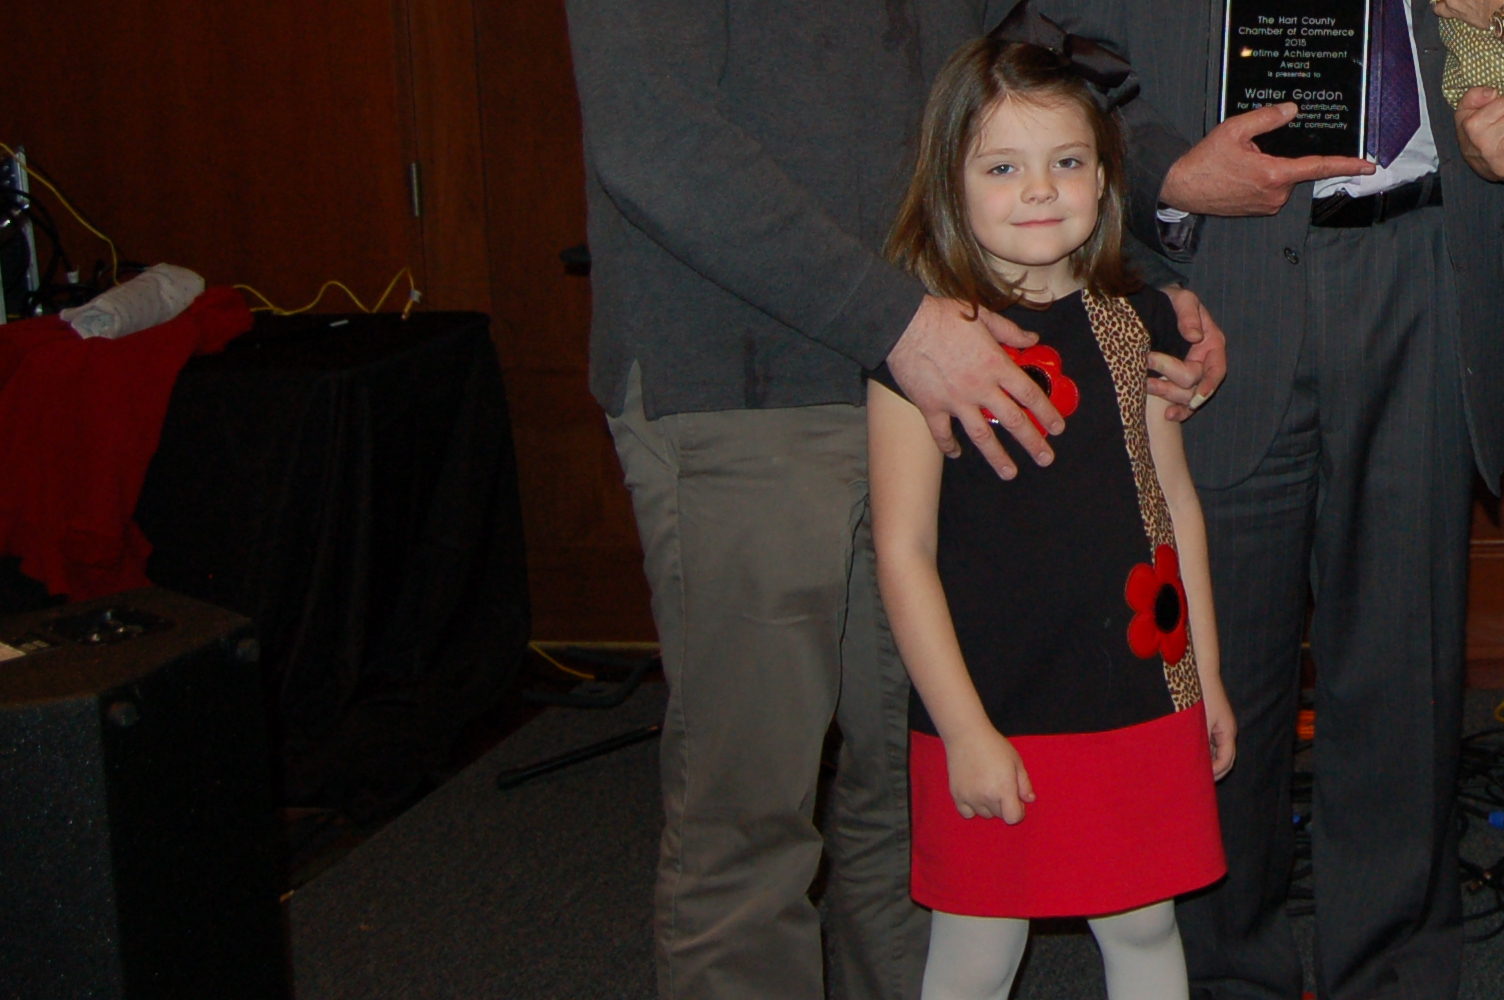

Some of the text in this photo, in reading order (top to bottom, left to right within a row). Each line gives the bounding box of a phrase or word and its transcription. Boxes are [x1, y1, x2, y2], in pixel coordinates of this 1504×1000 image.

[1258, 16, 1336, 27] The Hart County
[1238, 26, 1355, 36] Chamber of Commerce
[1284, 38, 1307, 47] 2015
[1283, 49, 1347, 59] Achievement
[1279, 60, 1310, 69] Award
[1275, 71, 1311, 79] presented
[1244, 87, 1343, 100] Walter Gordon
